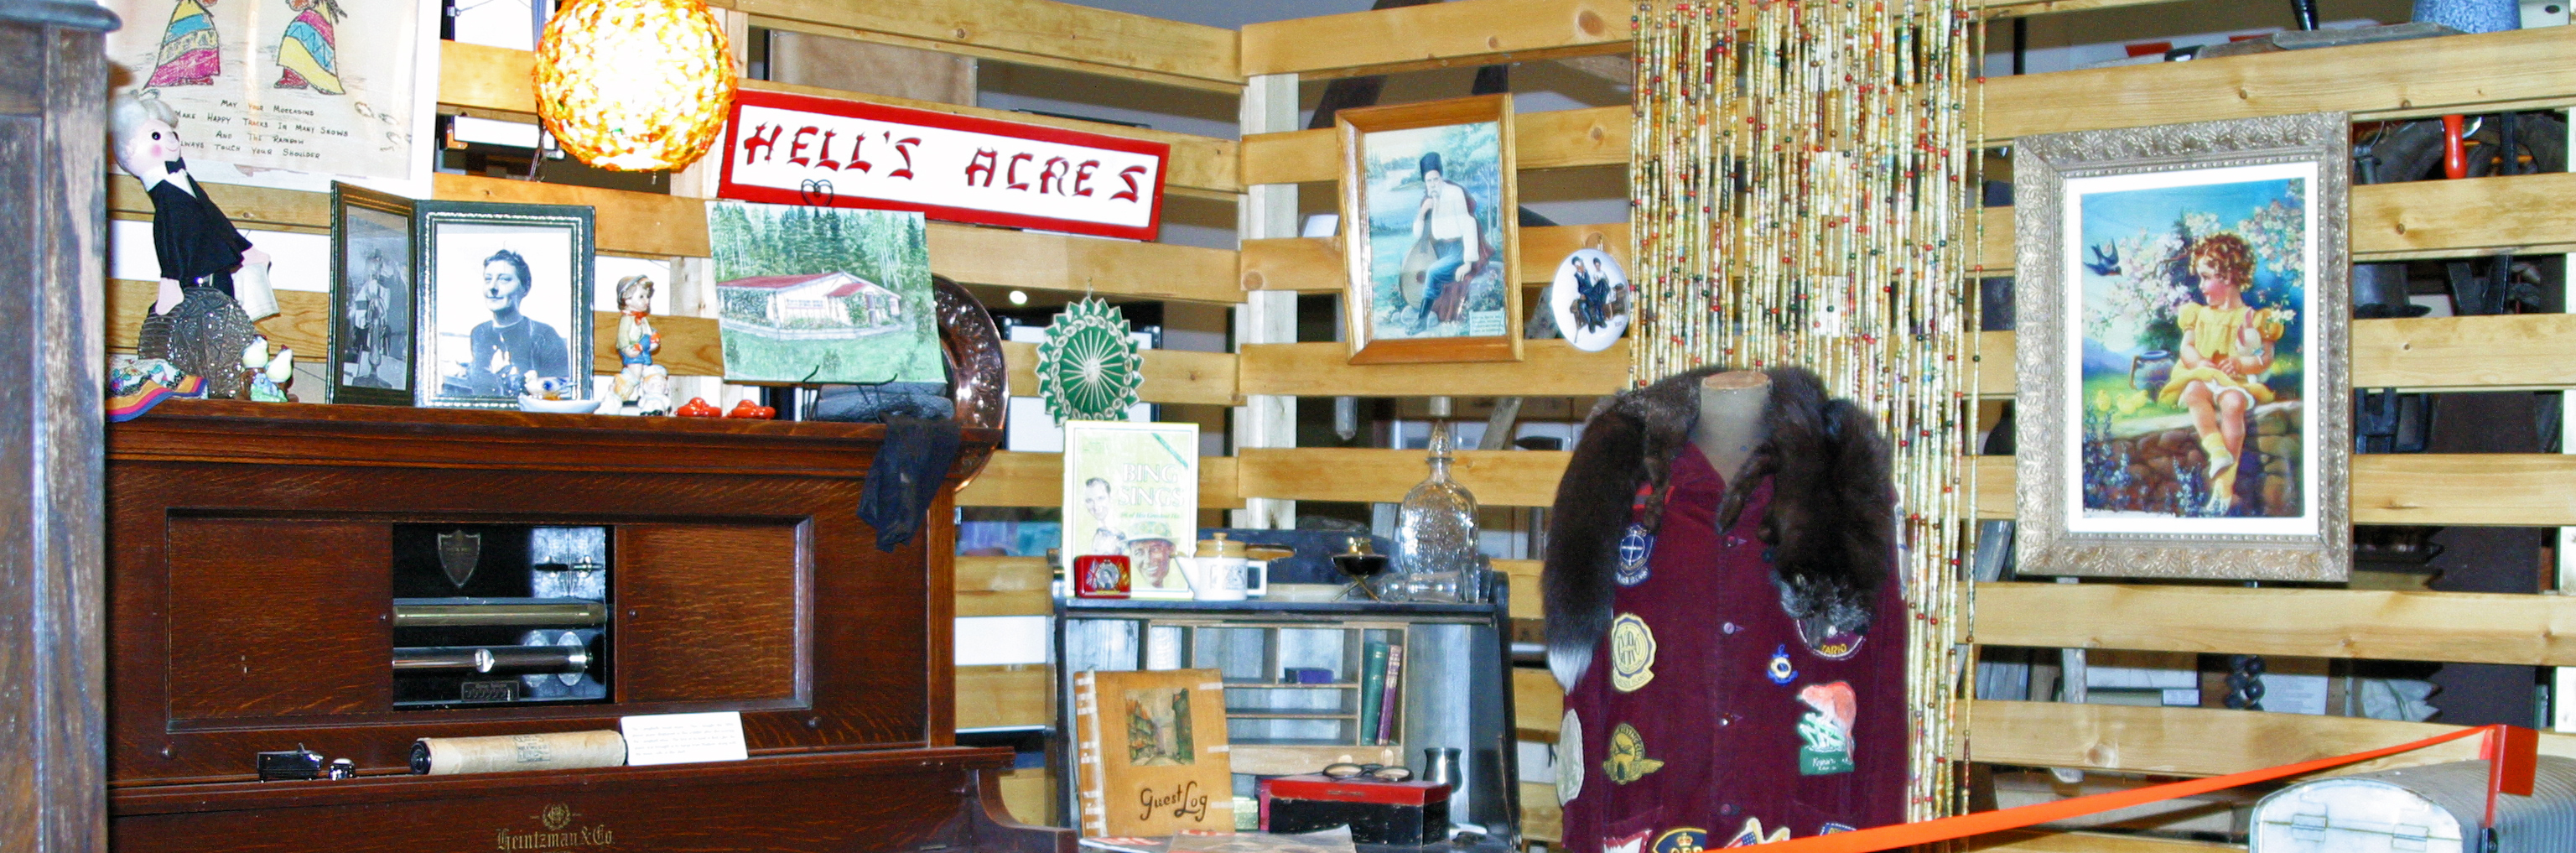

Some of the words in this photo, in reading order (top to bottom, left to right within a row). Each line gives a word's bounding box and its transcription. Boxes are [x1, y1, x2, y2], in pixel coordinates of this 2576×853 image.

[221, 100, 237, 108] MAY
[207, 112, 231, 124] HAPPY
[242, 117, 268, 127] TRACKS
[216, 130, 232, 139] AND
[247, 133, 262, 141] THE
[180, 140, 205, 148] LWAYS
[215, 143, 241, 152] TOUCH
[252, 147, 273, 155] YOUR
[283, 148, 320, 159] SHOULDER
[744, 121, 922, 180] HELL'S
[964, 146, 1149, 203] ACRES
[1123, 463, 1178, 483] BING
[1118, 486, 1185, 507] SINGS
[1821, 643, 1847, 655] TARIO
[1140, 783, 1182, 821] Guest
[1173, 780, 1208, 823] Log
[496, 828, 578, 852] Heintzman
